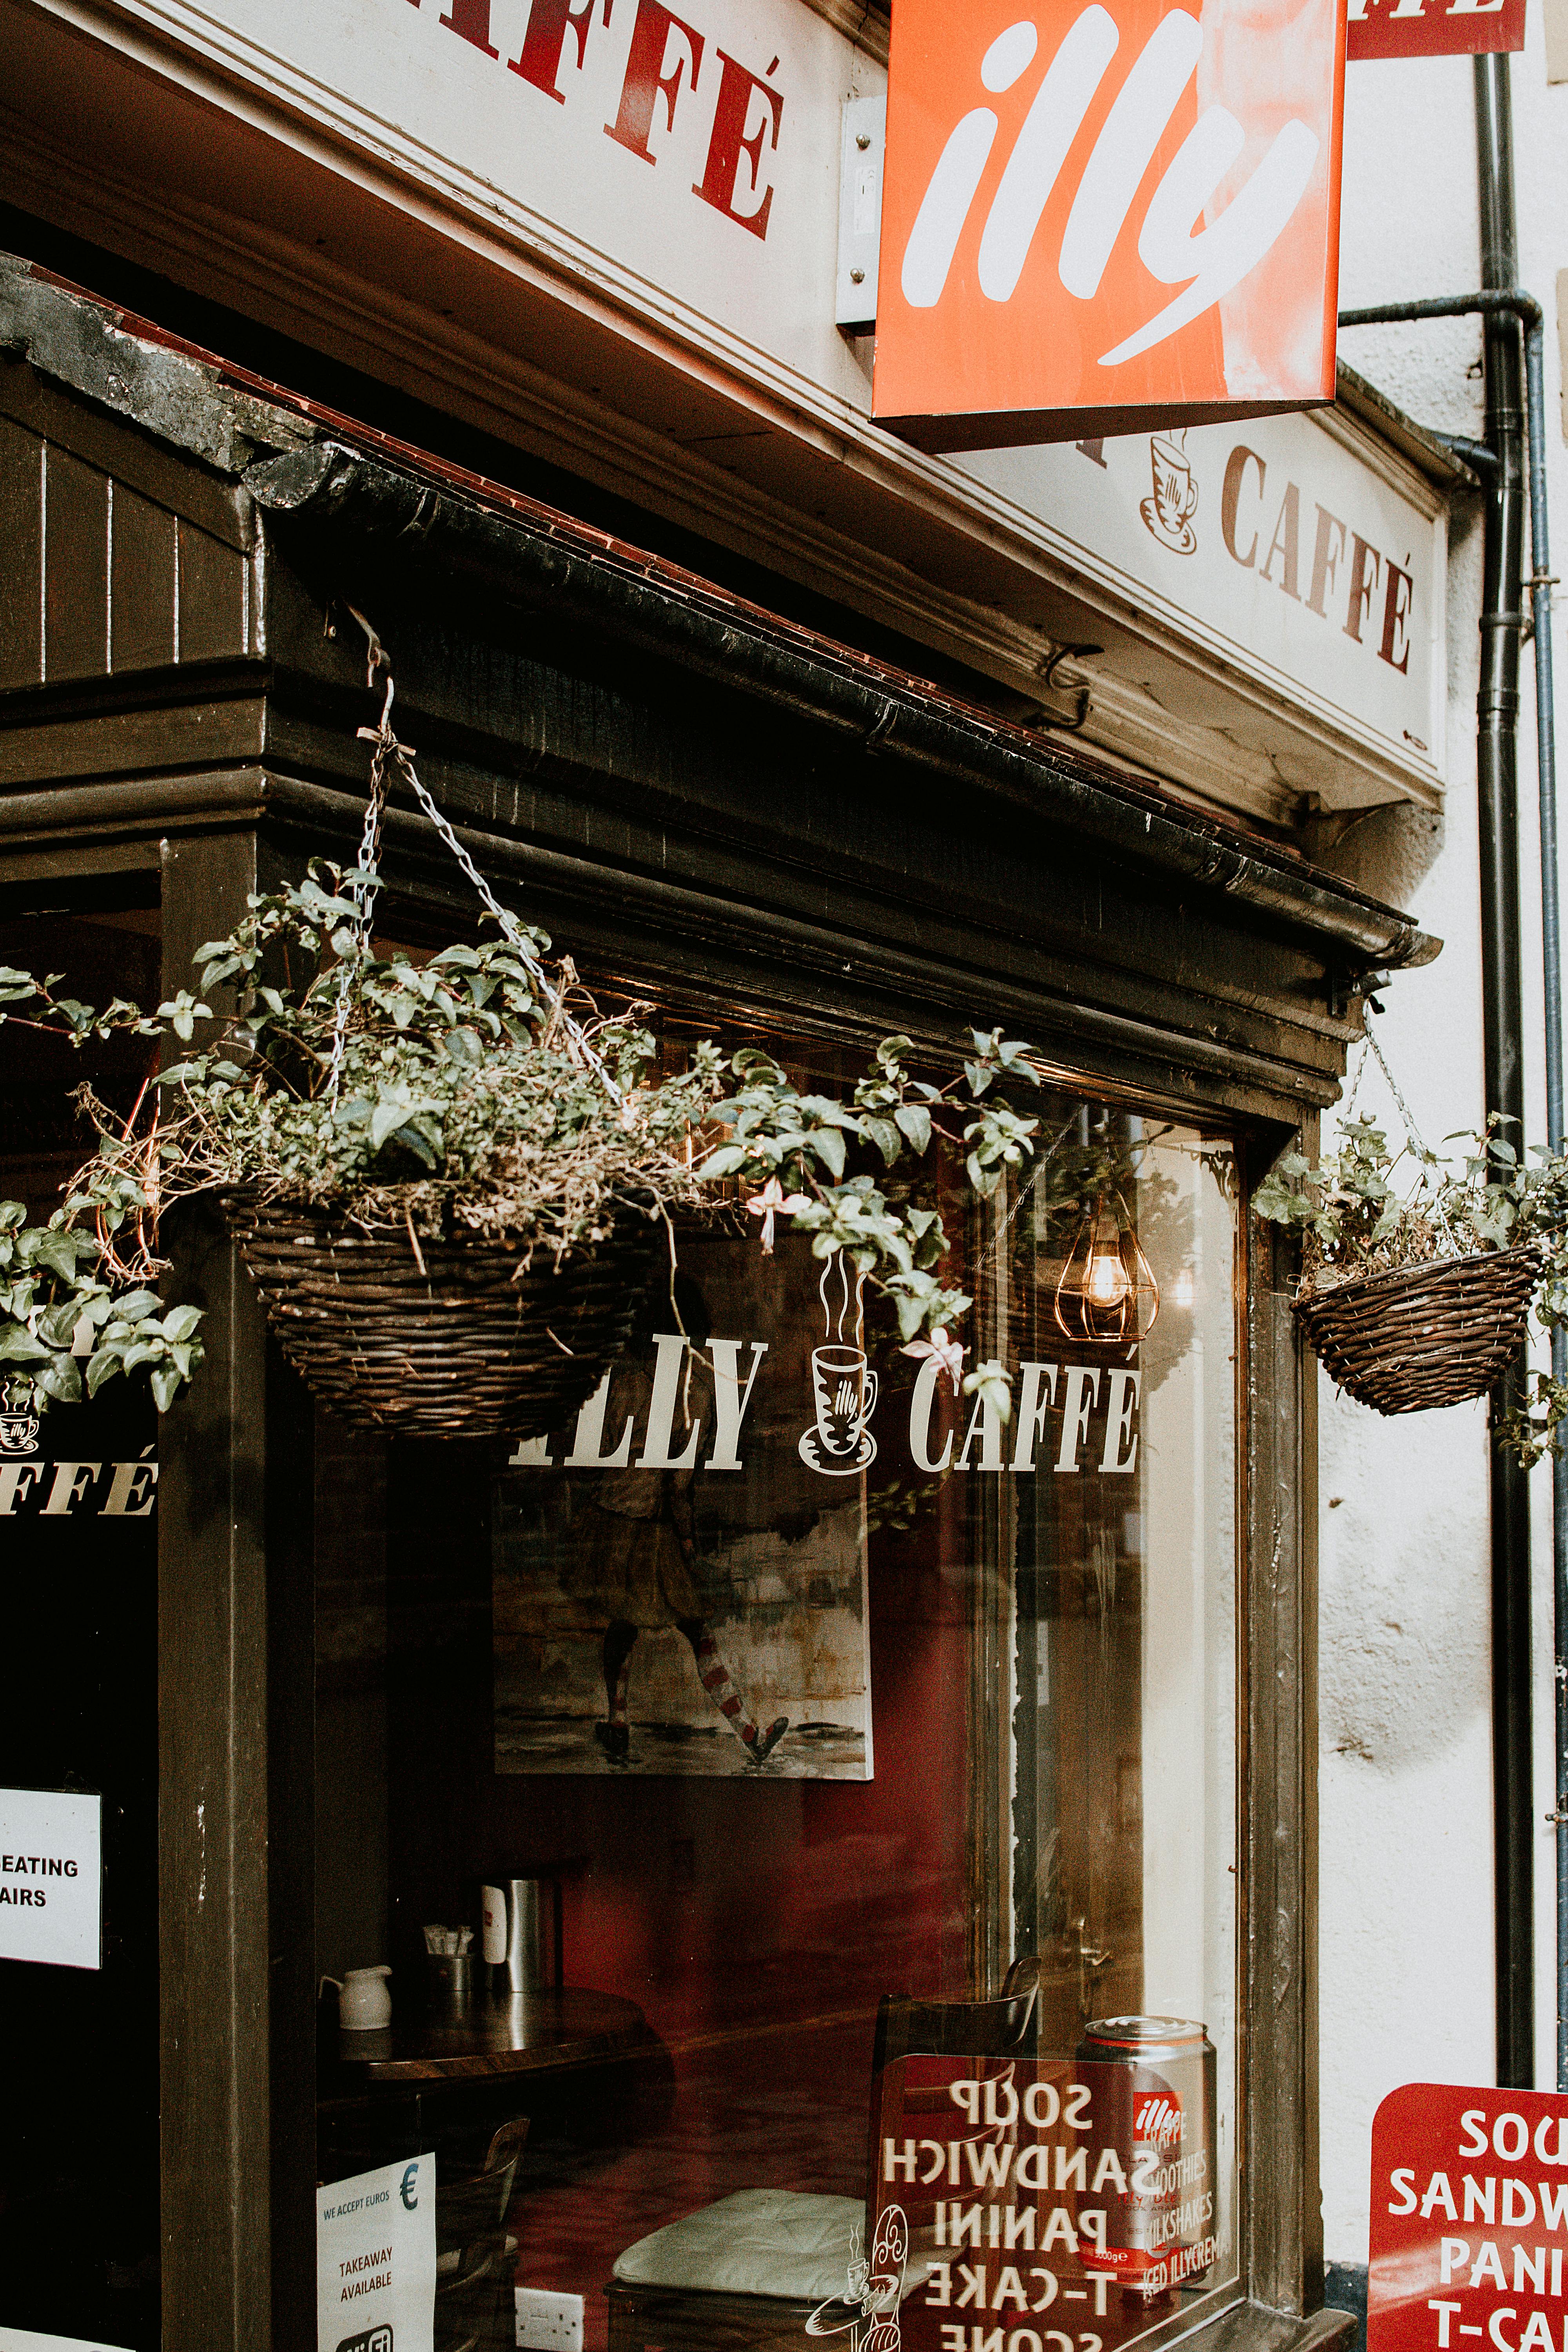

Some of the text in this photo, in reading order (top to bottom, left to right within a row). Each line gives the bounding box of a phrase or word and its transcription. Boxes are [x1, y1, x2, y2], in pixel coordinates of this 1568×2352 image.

[901, 4, 1320, 366] illy
[1165, 473, 1181, 512] illy
[1221, 445, 1413, 676] CAFFÉ
[508, 1334, 1142, 1473] LLY illy CAFFÉ
[11, 1423, 26, 1439] illy
[0, 1855, 78, 1877] EATING
[324, 2206, 336, 2220] WE
[338, 2198, 364, 2216] ACCEPT
[366, 2190, 390, 2207] EUROS
[339, 2247, 392, 2277] TAKEAWAY
[341, 2271, 391, 2302] AVAILABLE
[1428, 2299, 1568, 2352] T-CA
